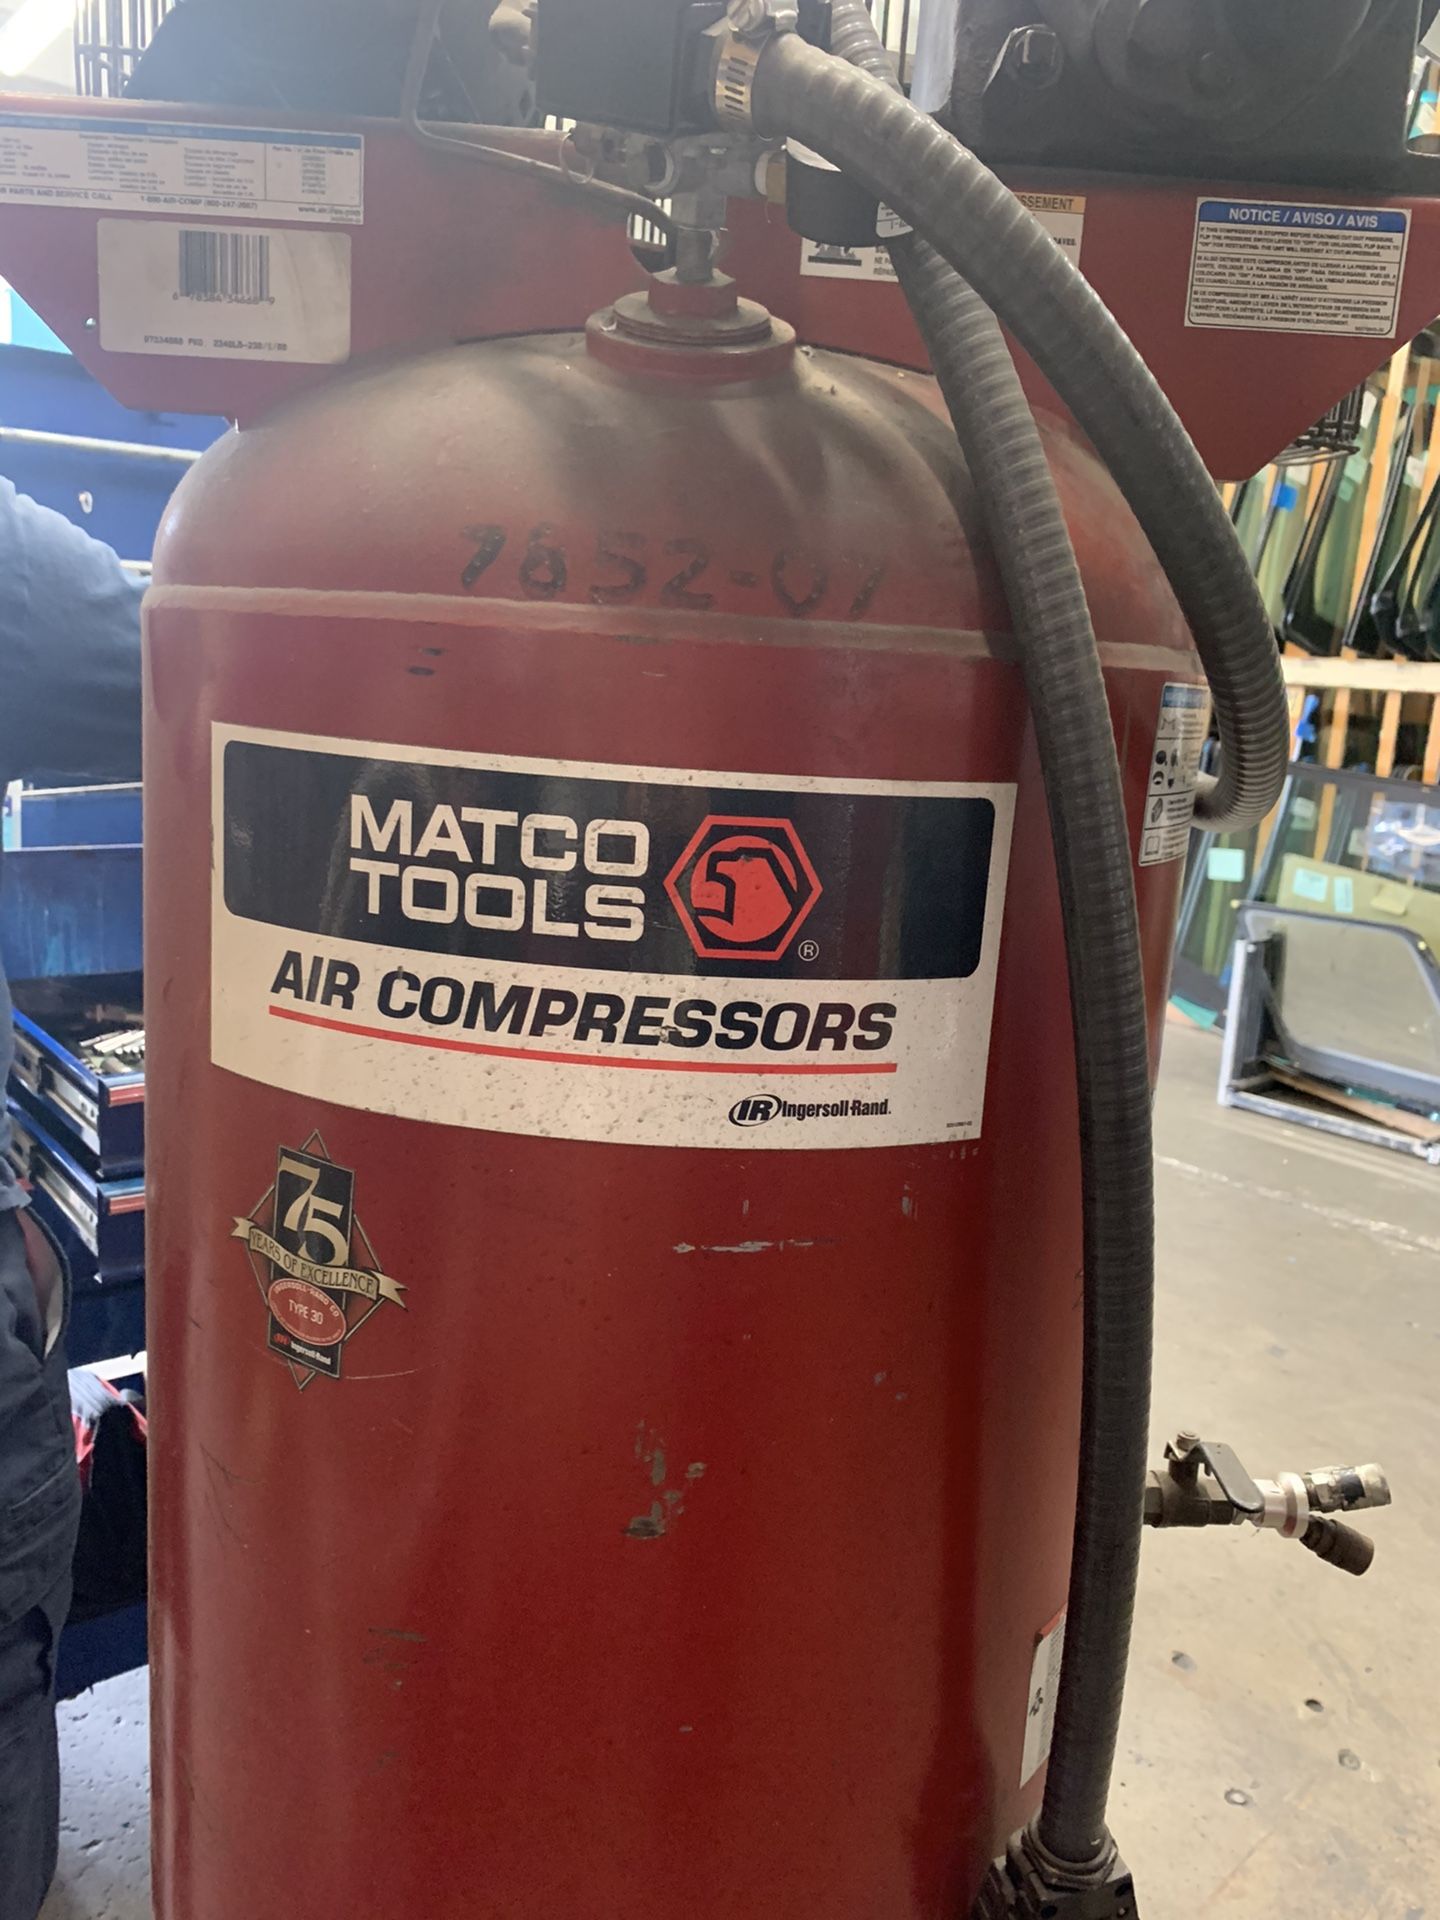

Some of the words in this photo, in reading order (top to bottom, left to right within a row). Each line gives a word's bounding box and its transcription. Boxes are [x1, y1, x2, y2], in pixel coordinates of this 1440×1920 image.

[1016, 194, 1074, 210] SSEMENT
[1229, 208, 1281, 222] NOTICE
[1292, 211, 1335, 226] AVISO
[1346, 214, 1378, 228] AVIS
[350, 794, 650, 877] MATCO
[350, 857, 646, 942] TOOLS
[269, 950, 360, 1011] AIR
[377, 966, 898, 1053] COMPRESSORS
[278, 1156, 349, 1267] 75
[250, 1230, 281, 1261] YEARS
[283, 1254, 298, 1276] OF
[300, 1263, 376, 1293] EXCELLENCE
[288, 1299, 309, 1319] TYPE
[310, 1309, 324, 1325] 30
